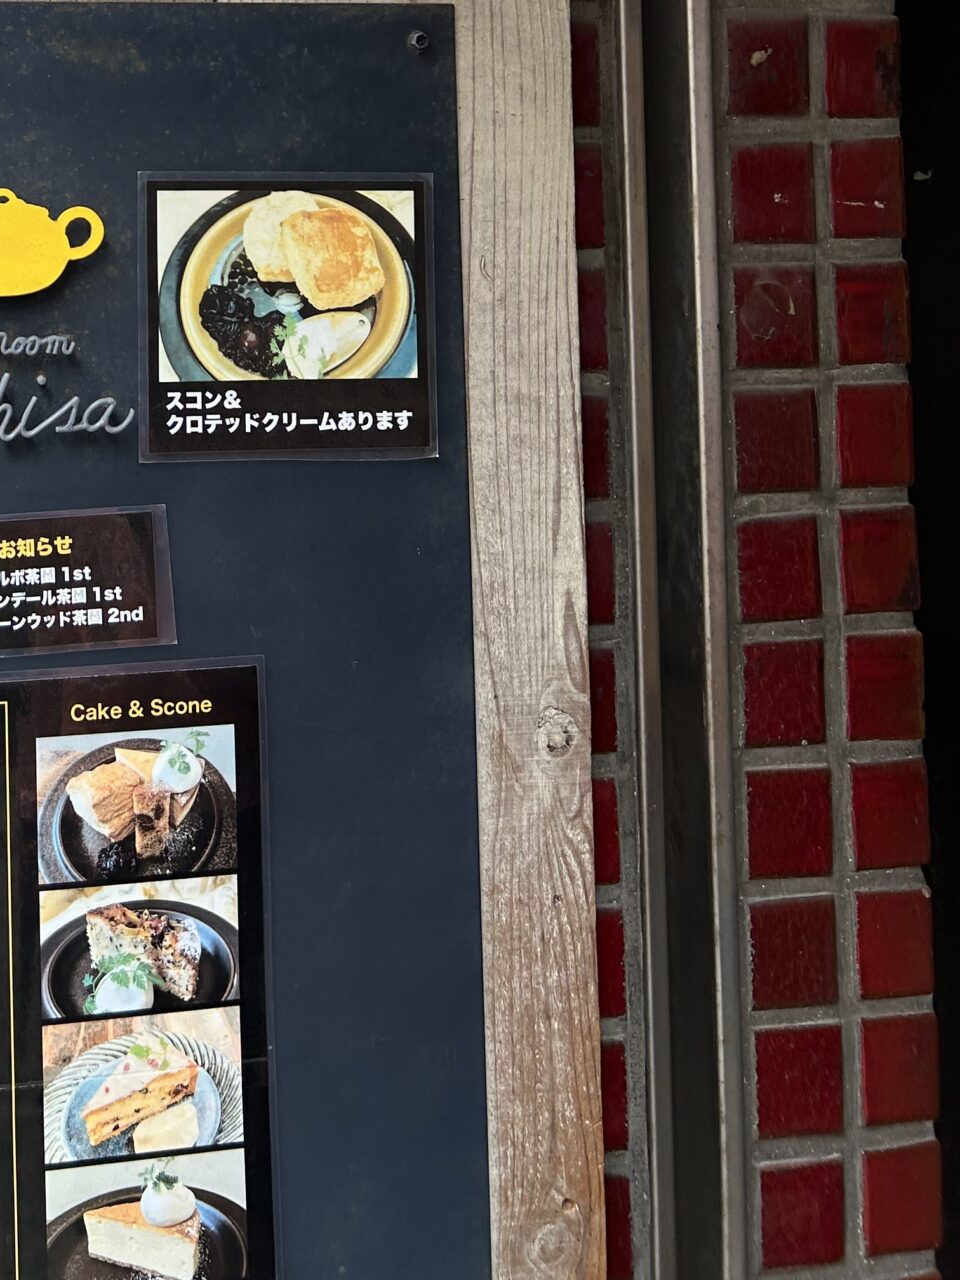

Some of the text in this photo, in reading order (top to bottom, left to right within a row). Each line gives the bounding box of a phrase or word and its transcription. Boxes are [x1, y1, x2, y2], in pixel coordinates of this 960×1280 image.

[166, 410, 414, 435] クロテッドクリームあります
[61, 566, 93, 583] 1st
[92, 585, 123, 602] 1st
[108, 606, 144, 623] 2nd
[70, 698, 213, 722] Cake & Scone
